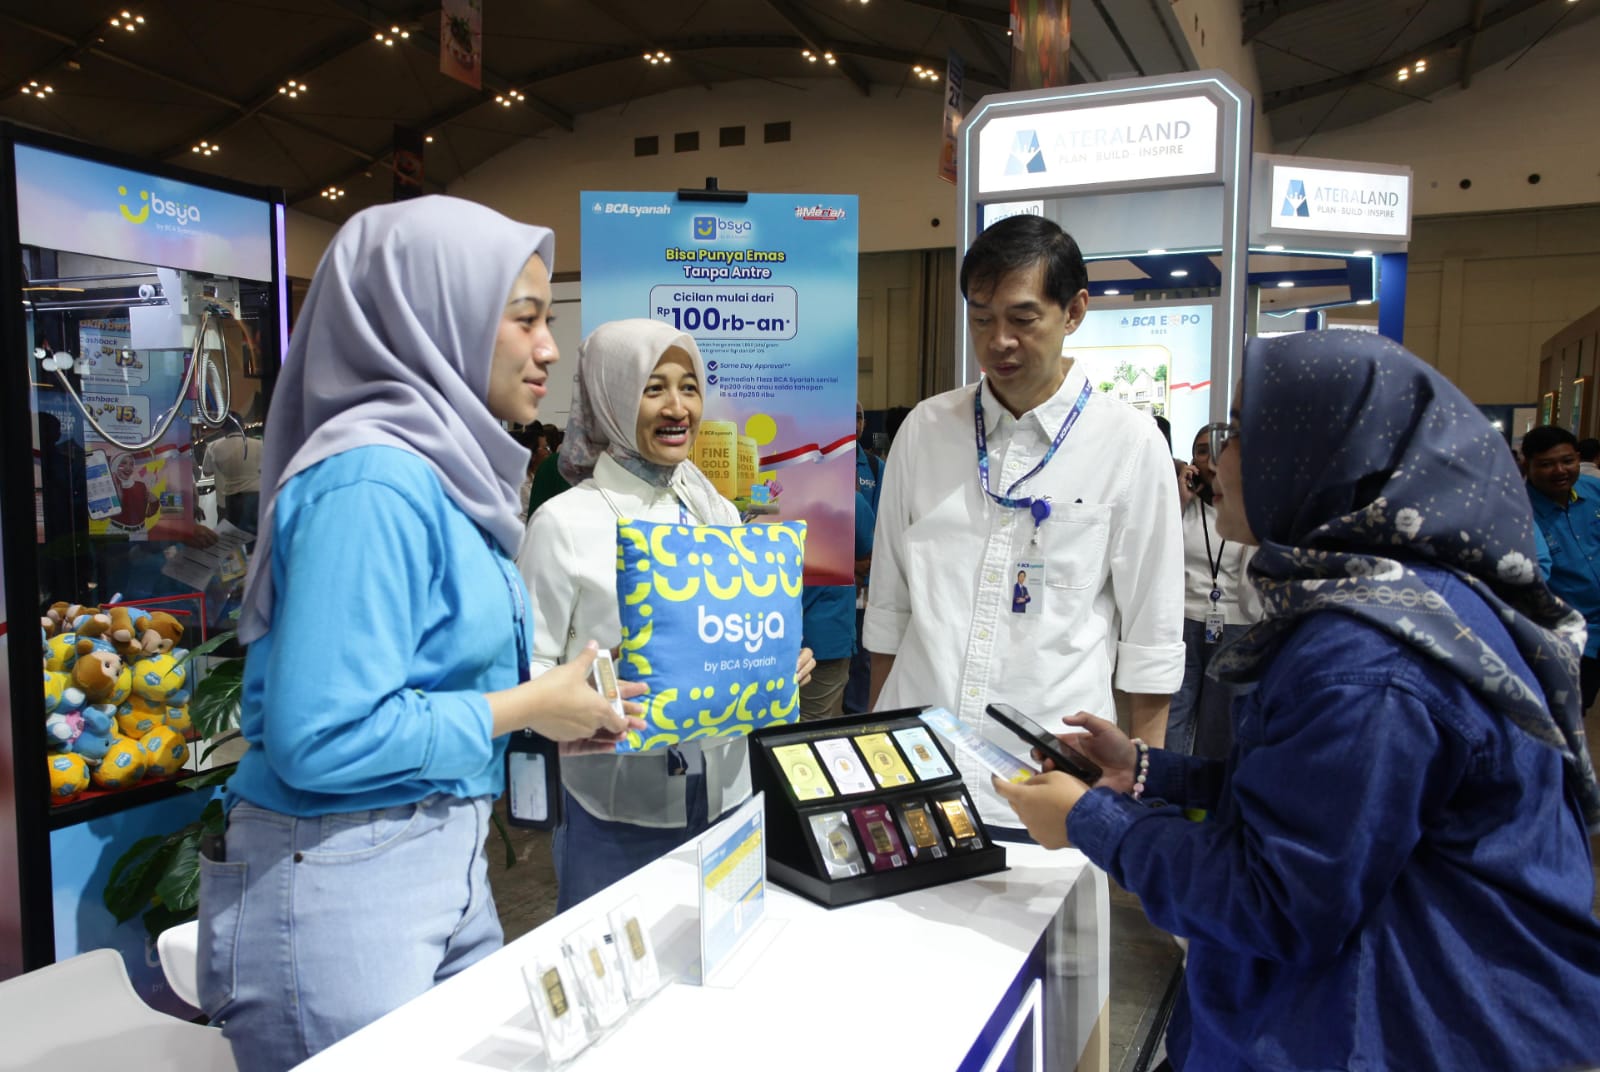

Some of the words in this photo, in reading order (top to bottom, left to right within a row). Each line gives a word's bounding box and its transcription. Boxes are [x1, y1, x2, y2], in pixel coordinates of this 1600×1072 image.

[1054, 120, 1192, 148] ATERALAND
[1058, 153, 1088, 164] PLAN
[1096, 149, 1130, 163] BUILD
[1139, 144, 1184, 157] INSPIRE
[1314, 187, 1399, 207] ATERALAND
[1317, 206, 1336, 214] PLAN
[1341, 207, 1363, 216] BUILD
[1367, 209, 1395, 218] INSPIRE
[718, 217, 752, 234] bsya
[666, 248, 696, 262] Bisa
[699, 250, 745, 265] Punya
[746, 250, 785, 263] Emas
[683, 265, 729, 281] Tanpa
[732, 266, 771, 279] Antre
[673, 292, 713, 303] Cicilan
[716, 292, 750, 303] mulai
[752, 293, 774, 303] dari
[1132, 315, 1156, 327] BCA
[789, 376, 814, 384] Syariah
[702, 448, 730, 458] FINE
[737, 454, 754, 463] INE
[702, 460, 730, 469] GOLD
[697, 604, 785, 653] bsya
[704, 661, 718, 675] by
[720, 660, 741, 671] BCA
[742, 656, 777, 669] Syariah
